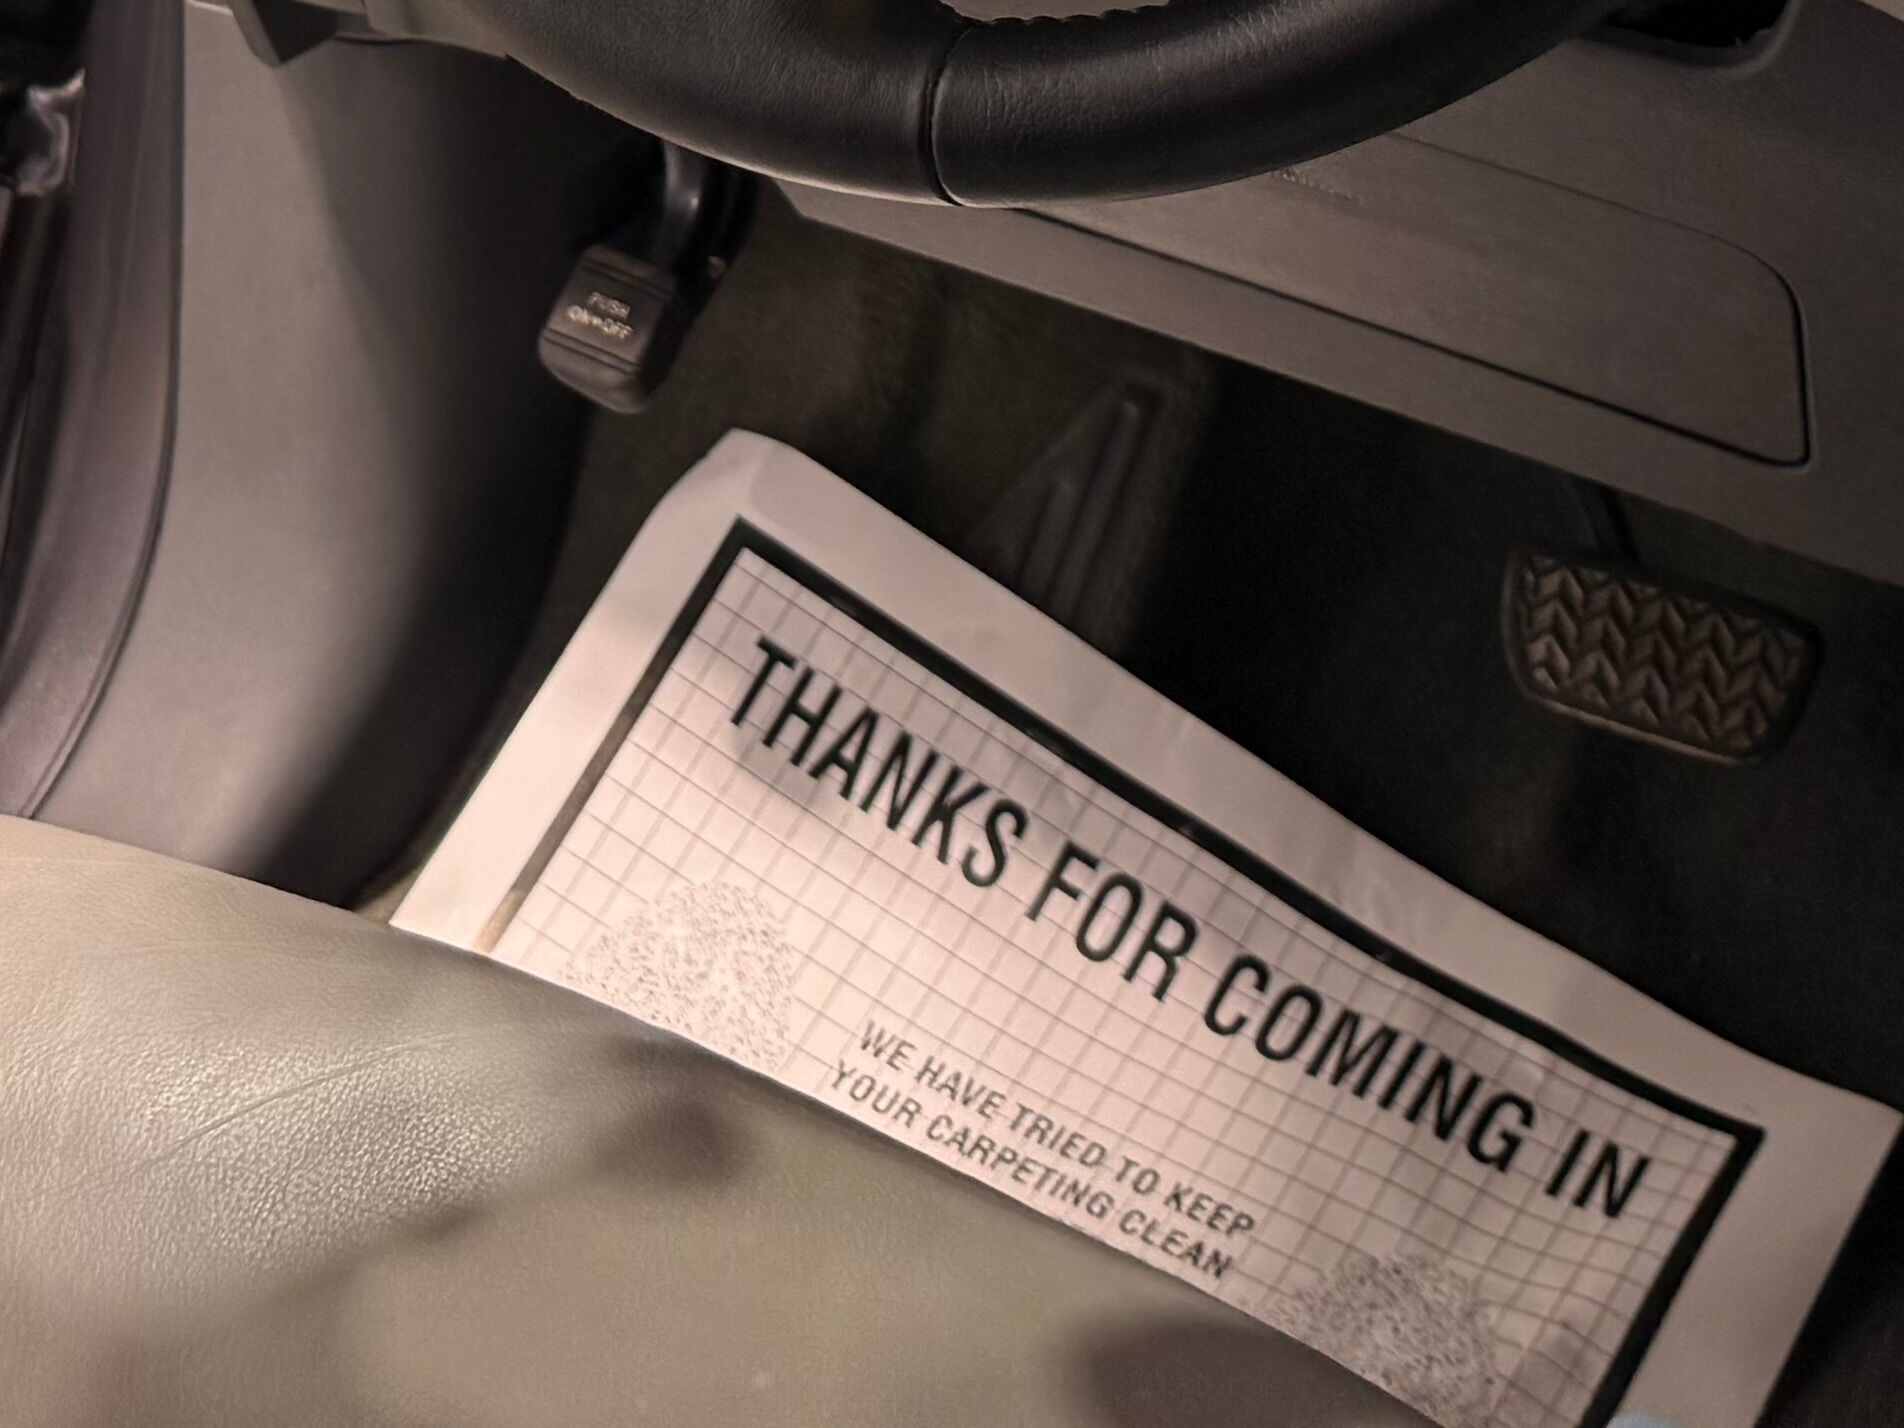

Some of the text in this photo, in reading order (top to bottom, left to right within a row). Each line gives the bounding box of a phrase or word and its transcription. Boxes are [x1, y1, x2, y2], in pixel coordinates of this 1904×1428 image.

[727, 637, 1654, 1220] THANKS FOR COMING IN
[830, 1058, 1233, 1280] YOUR CARPETING CLEAN
[858, 1018, 1256, 1240] WE HAVE TRIED TO KEEP
